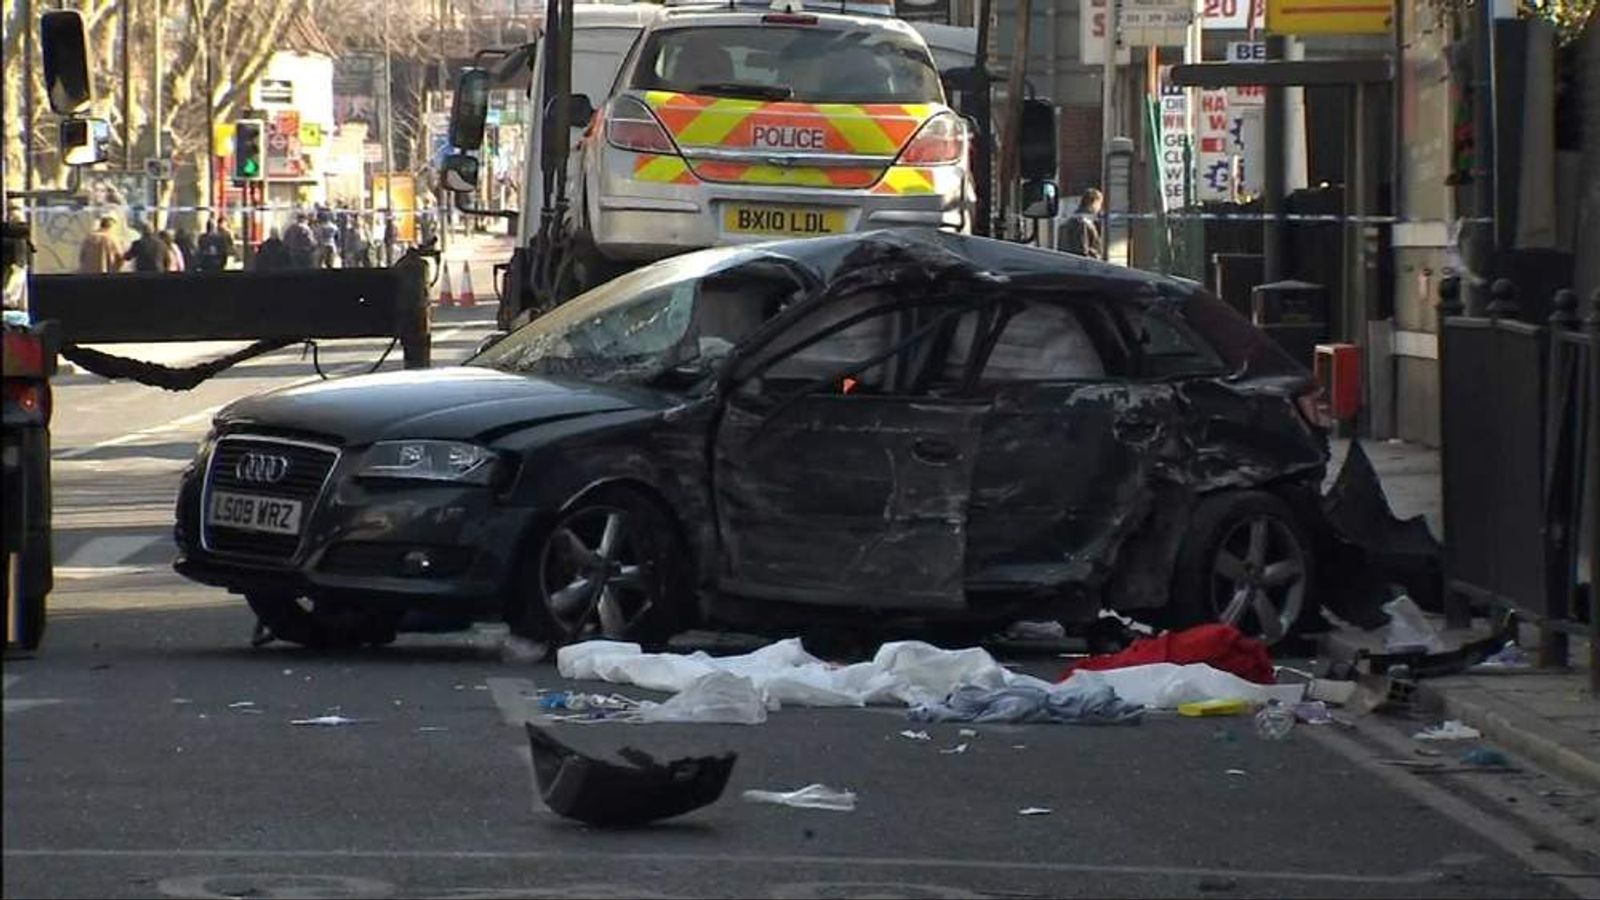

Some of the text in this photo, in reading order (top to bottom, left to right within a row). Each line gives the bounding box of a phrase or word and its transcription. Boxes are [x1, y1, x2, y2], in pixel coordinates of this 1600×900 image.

[753, 126, 824, 148] POLICE
[738, 209, 831, 233] BX10 LDL
[214, 495, 294, 528] LS09 WRZ
